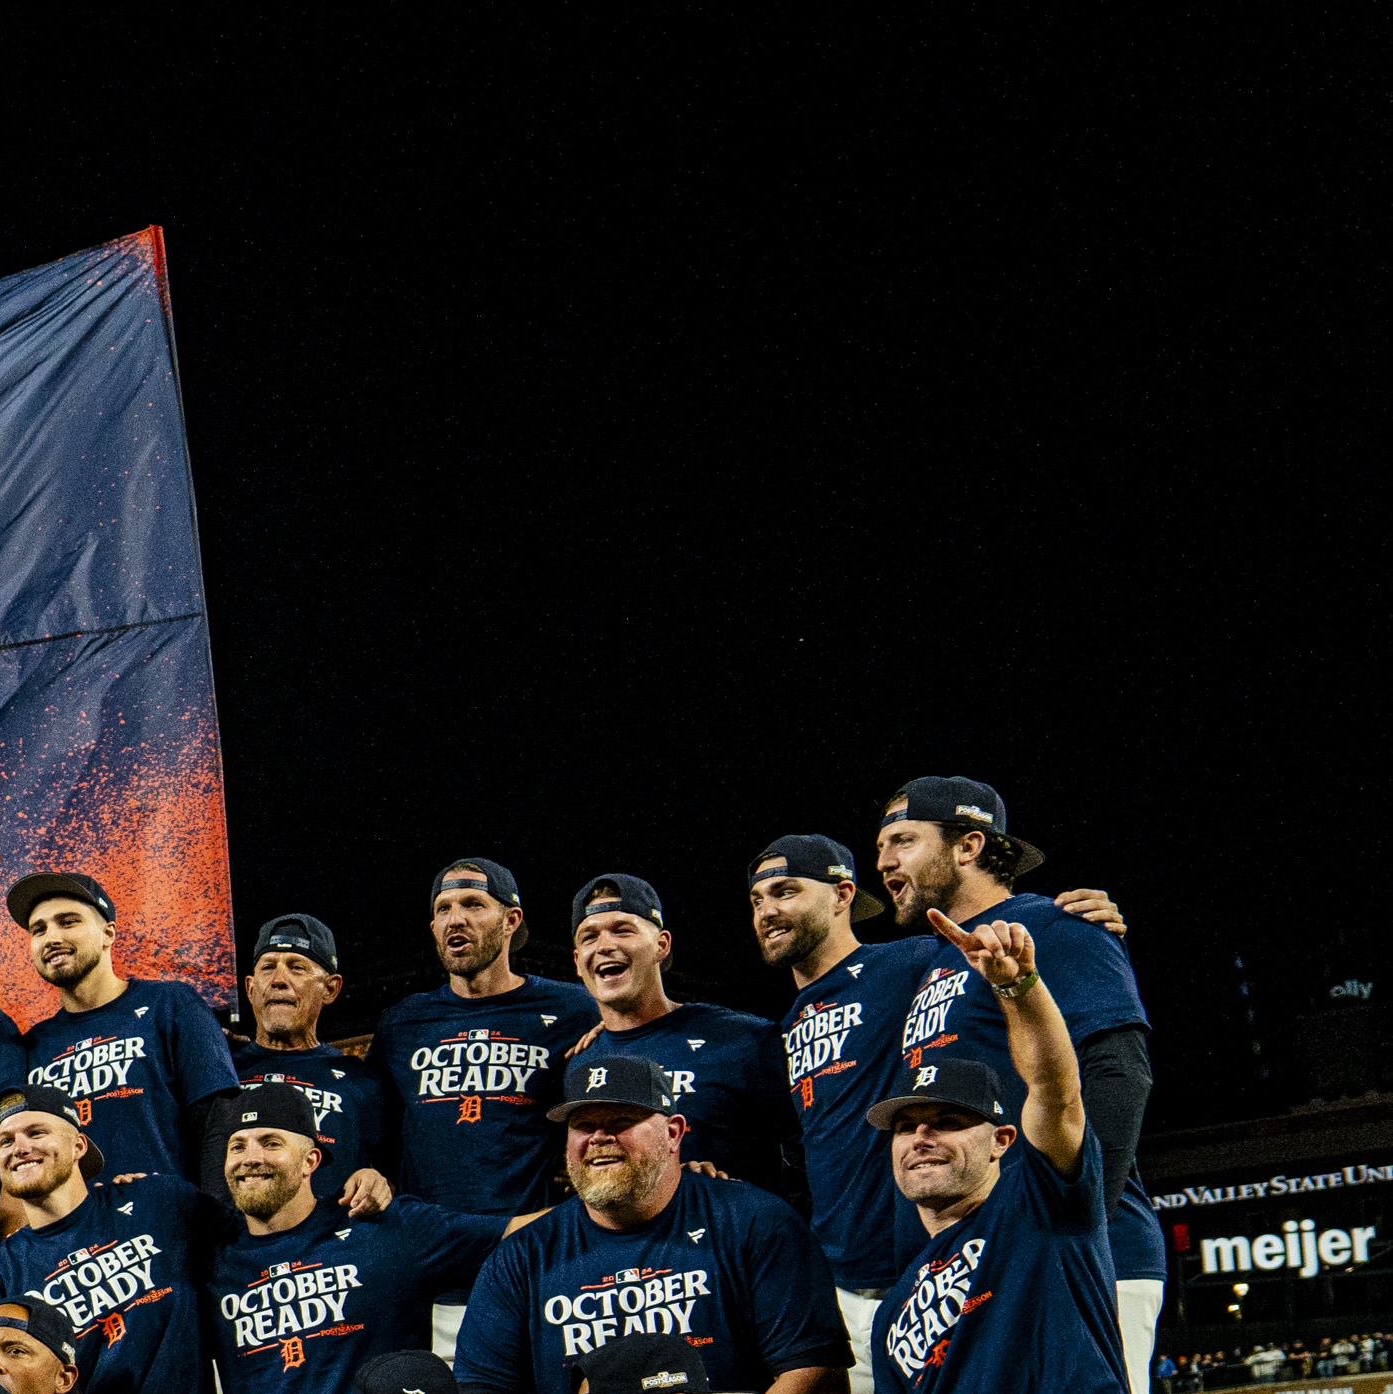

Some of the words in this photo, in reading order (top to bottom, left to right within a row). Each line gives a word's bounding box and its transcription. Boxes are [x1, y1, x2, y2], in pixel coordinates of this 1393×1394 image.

[907, 970, 969, 1019] TOBER
[411, 1038, 550, 1070] OCTOBER
[902, 999, 954, 1054] EADY
[28, 1036, 146, 1086] OCTOBER
[418, 1066, 535, 1098] READY
[1270, 1175, 1343, 1196] STATE
[1201, 1219, 1376, 1278] meijer
[221, 1264, 363, 1321] OCTOBER
[234, 1291, 348, 1348] READY
[545, 1269, 711, 1325] OCTOBER
[886, 1238, 986, 1355] OCTOBER
[563, 1299, 697, 1357] READY
[643, 1373, 687, 1388] POSTSEASON
